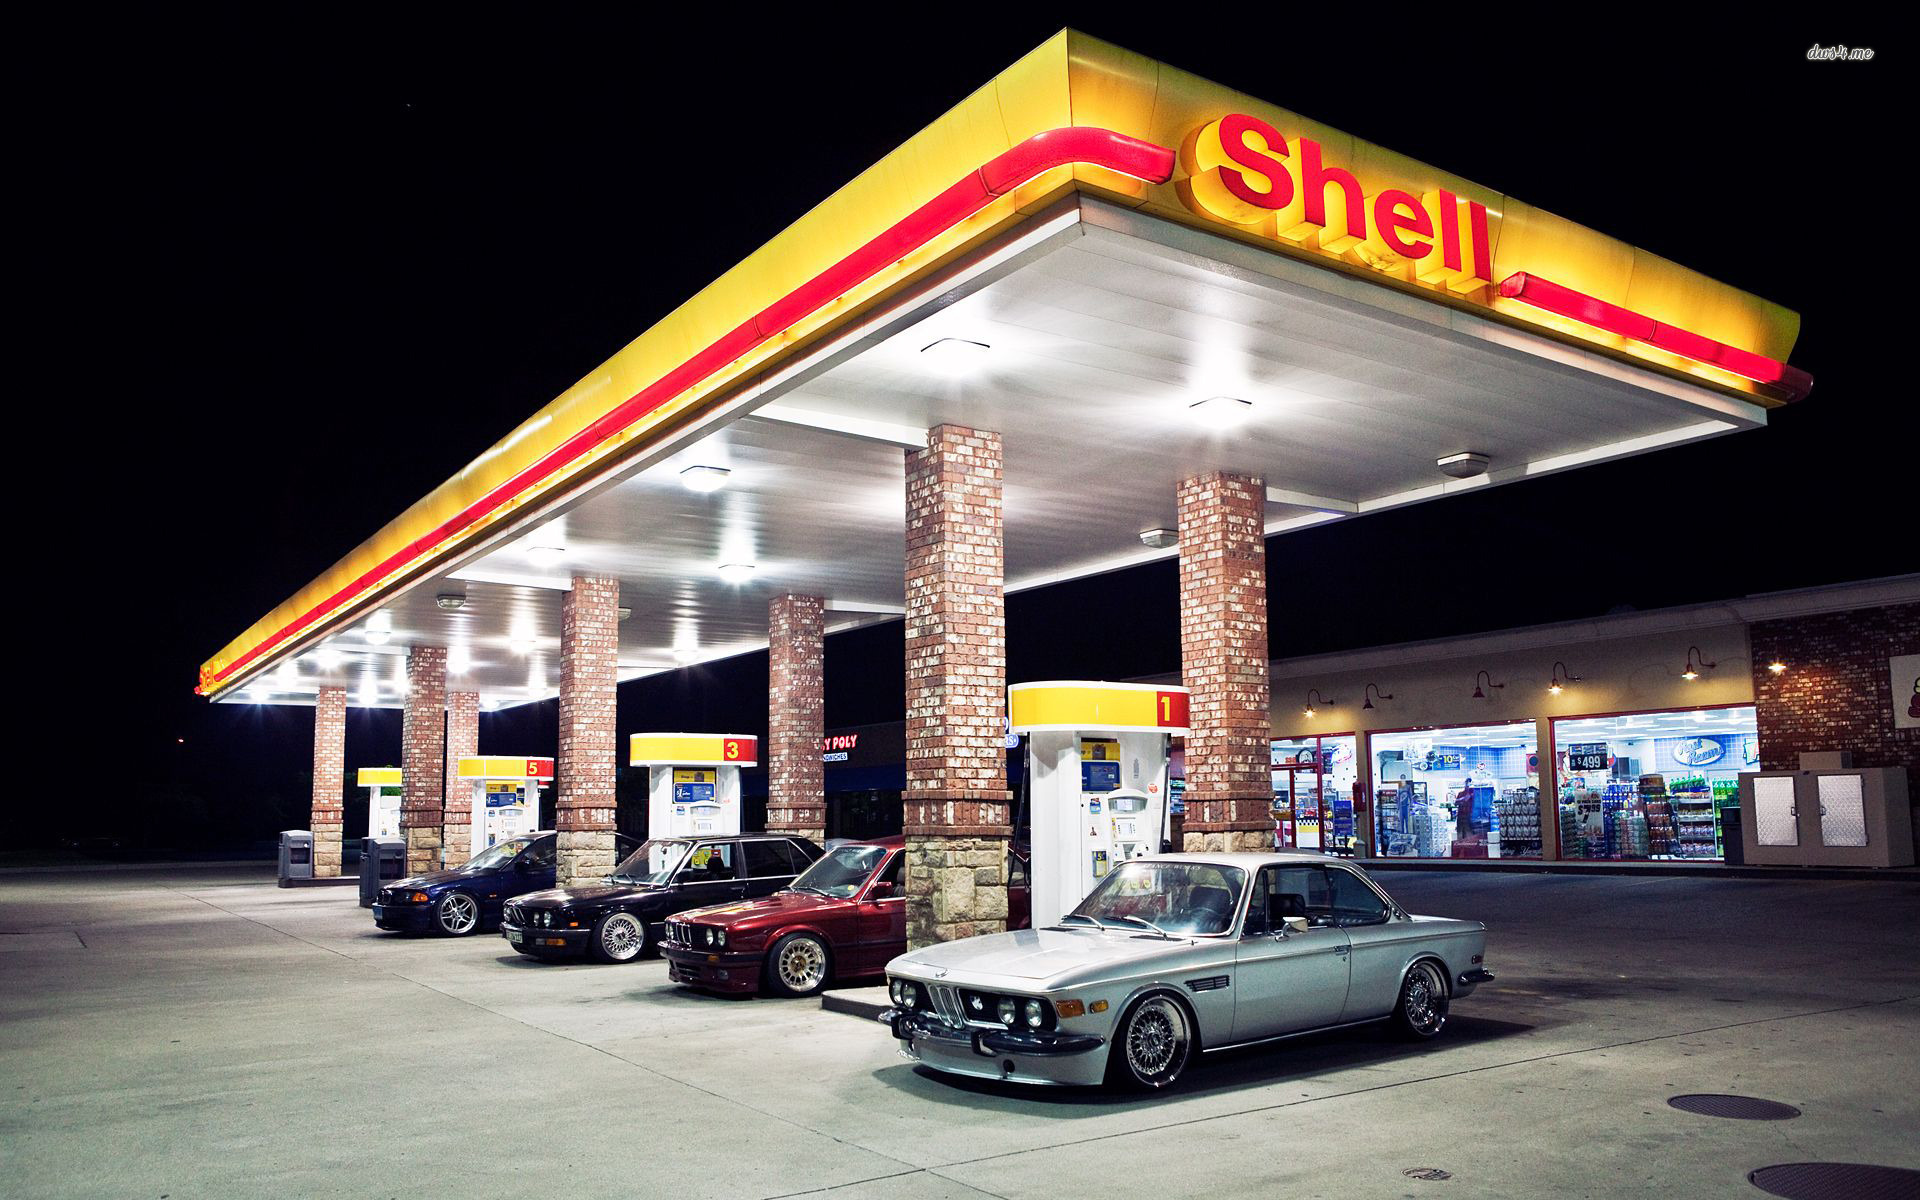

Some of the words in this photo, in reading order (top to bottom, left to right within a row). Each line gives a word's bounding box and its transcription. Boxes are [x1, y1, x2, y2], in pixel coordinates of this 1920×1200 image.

[1218, 113, 1492, 282] Shell
[1161, 696, 1170, 721] 1
[727, 742, 739, 758] 3
[832, 734, 857, 750] POLY
[823, 752, 848, 761] NDWICHES
[529, 762, 537, 774] 5
